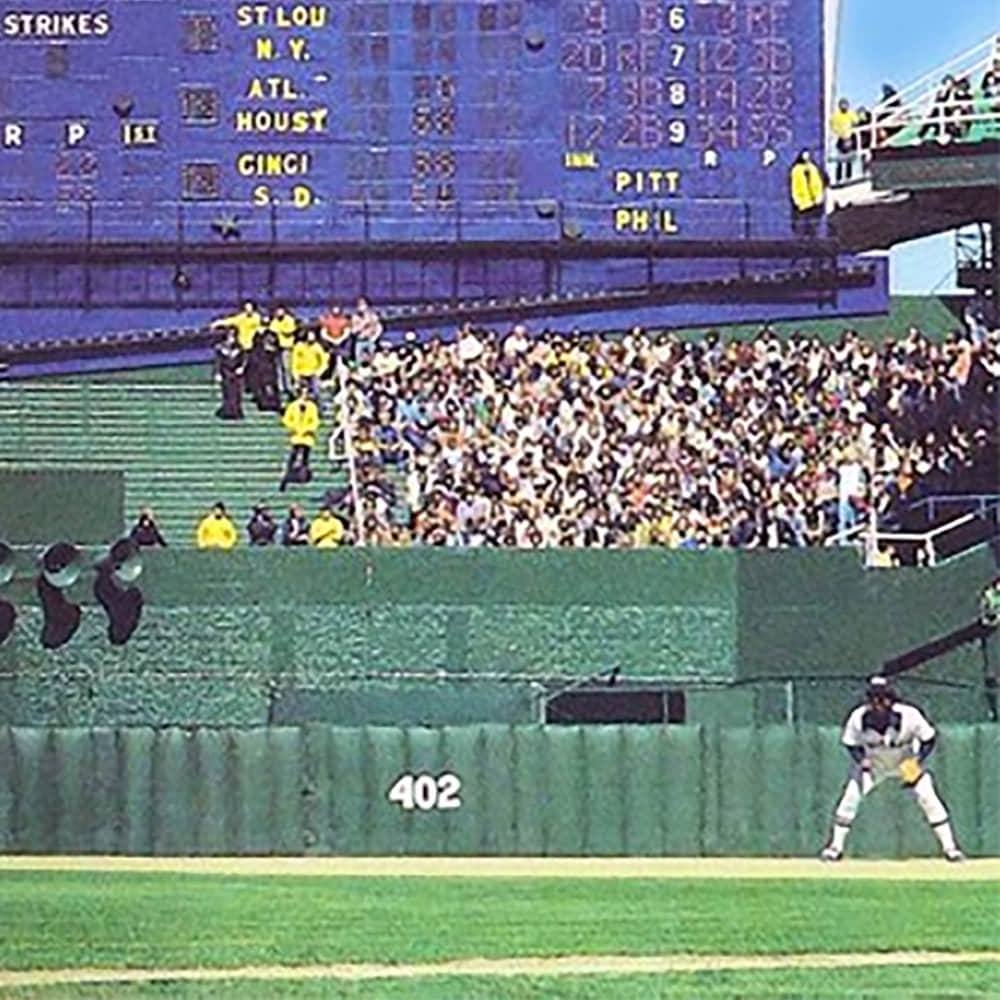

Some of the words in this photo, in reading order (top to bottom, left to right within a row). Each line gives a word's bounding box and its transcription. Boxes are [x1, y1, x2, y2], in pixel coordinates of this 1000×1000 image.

[4, 14, 109, 35] STRIKES
[237, 5, 269, 27] ST
[276, 5, 326, 28] LOU
[669, 7, 685, 30] 6
[671, 44, 685, 67] 7
[666, 78, 685, 105] 8
[236, 109, 328, 133] HOUST
[669, 121, 685, 143] 9
[5, 124, 22, 145] R
[69, 121, 86, 145] P
[238, 153, 308, 176] CINCI
[762, 149, 777, 167] P
[616, 171, 679, 193] PITT
[388, 772, 461, 809] 402
